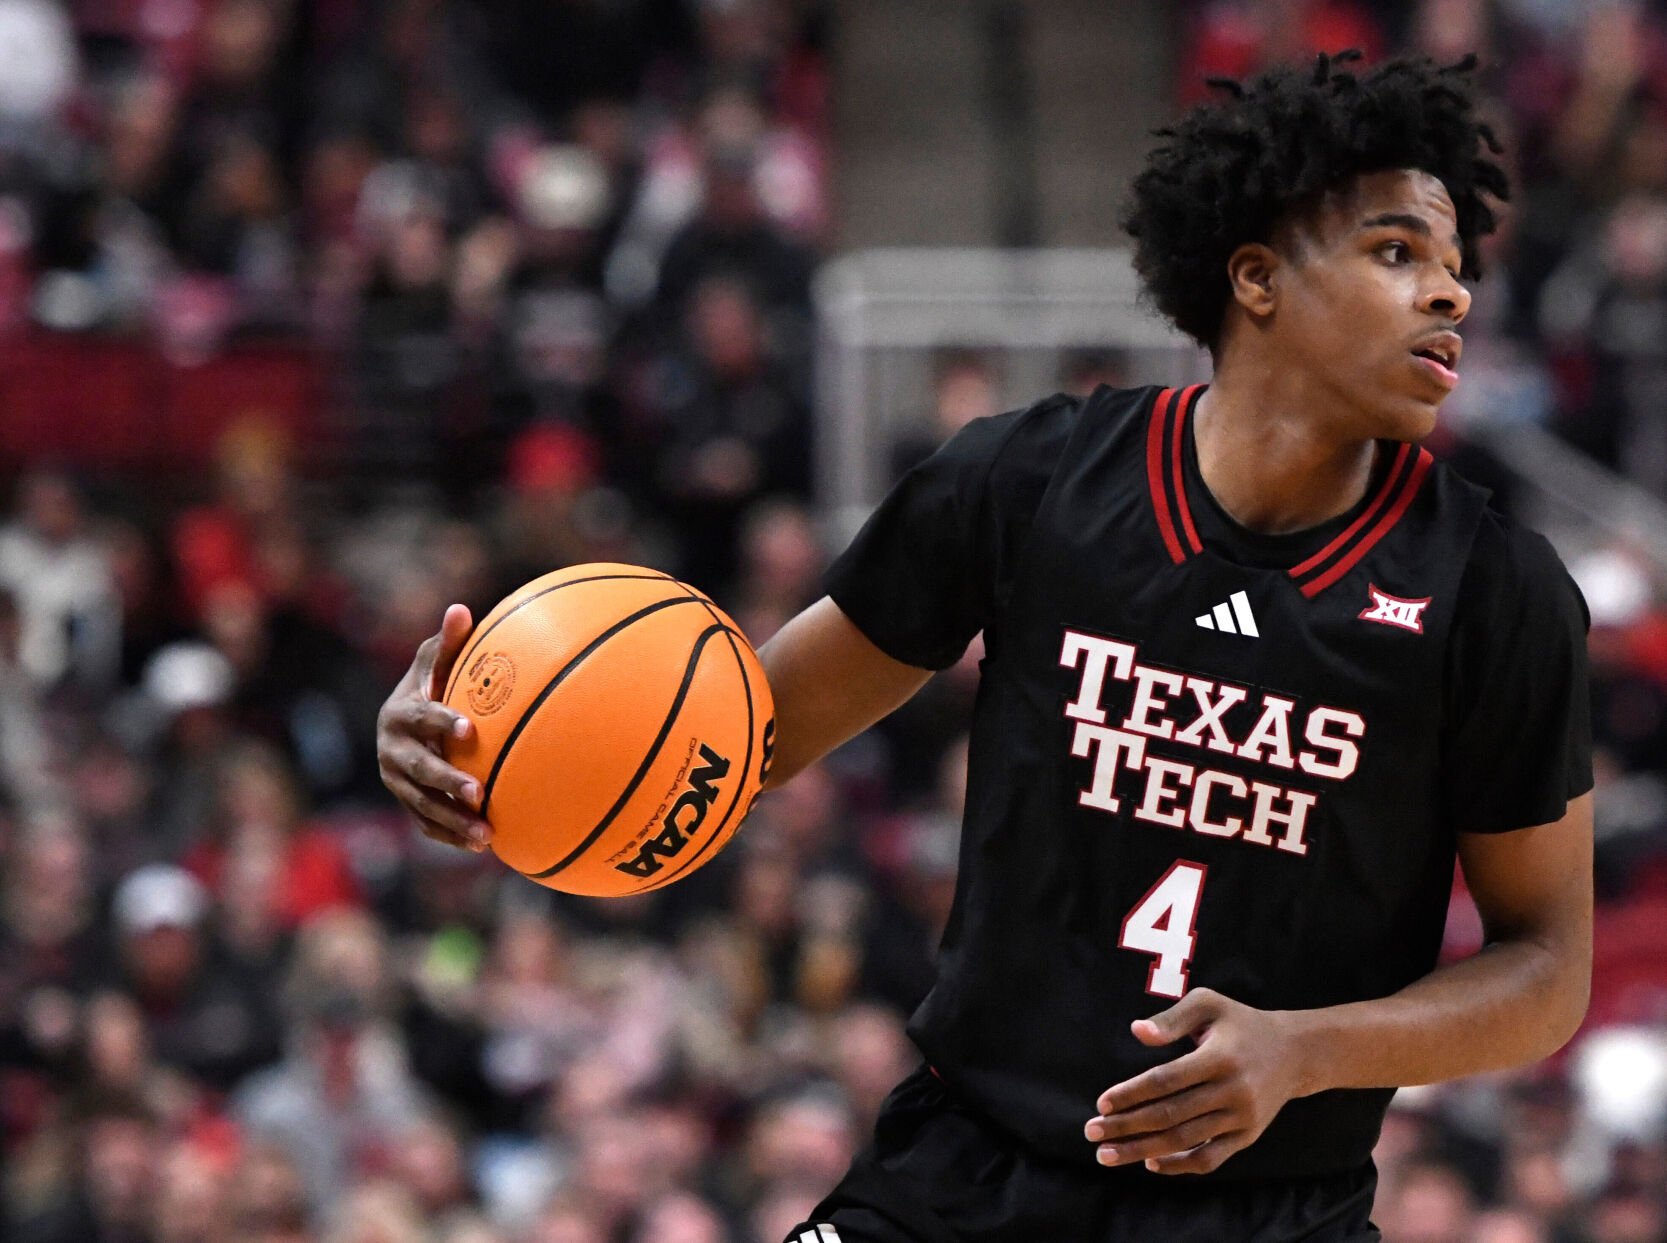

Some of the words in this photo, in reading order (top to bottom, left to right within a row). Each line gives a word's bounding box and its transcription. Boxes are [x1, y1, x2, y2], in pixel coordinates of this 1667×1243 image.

[1362, 589, 1427, 631] XII
[665, 737, 698, 800] OFFICIAL
[1059, 629, 1366, 781] TEXAS
[604, 840, 638, 864] BALL
[614, 742, 730, 878] NCAA
[1070, 722, 1317, 855] TECH
[1117, 859, 1208, 1000] 4
